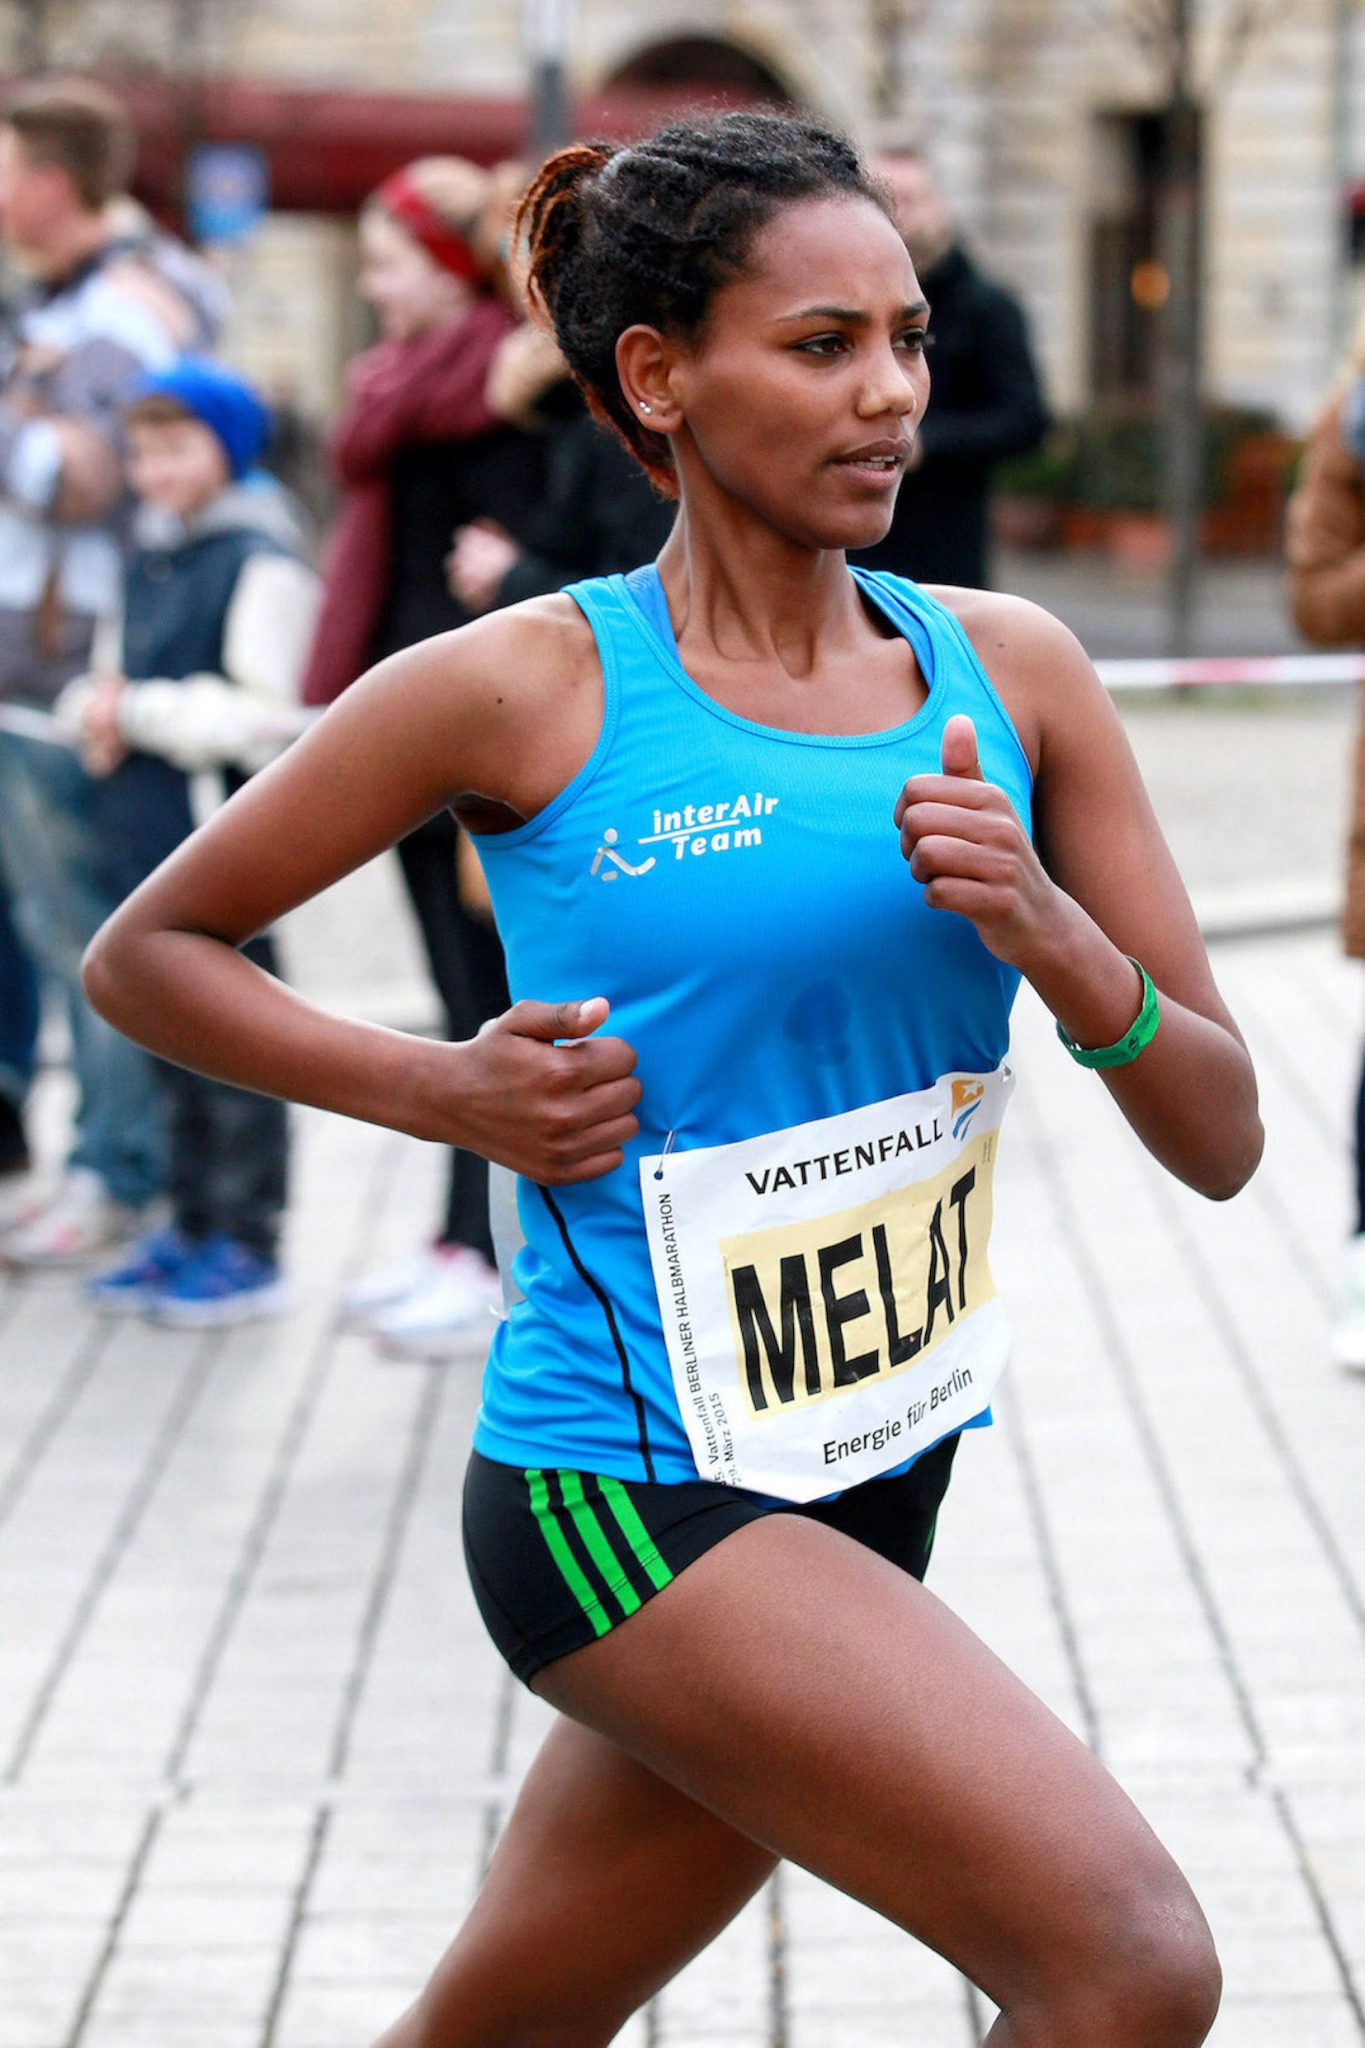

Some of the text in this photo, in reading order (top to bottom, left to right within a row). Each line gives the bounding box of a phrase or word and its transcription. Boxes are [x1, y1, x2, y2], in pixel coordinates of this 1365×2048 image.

[652, 791, 780, 835] interAir
[671, 826, 762, 861] Team
[745, 1118, 944, 1195] VATTENFALL
[658, 1193, 689, 1318] HALBMARATHON
[731, 1165, 976, 1411] MELAT
[679, 1321, 702, 1393] BERLINER
[692, 1396, 719, 1465] Vattenfall
[709, 1392, 728, 1426] 2015
[823, 1368, 974, 1465] Energie für Berlin
